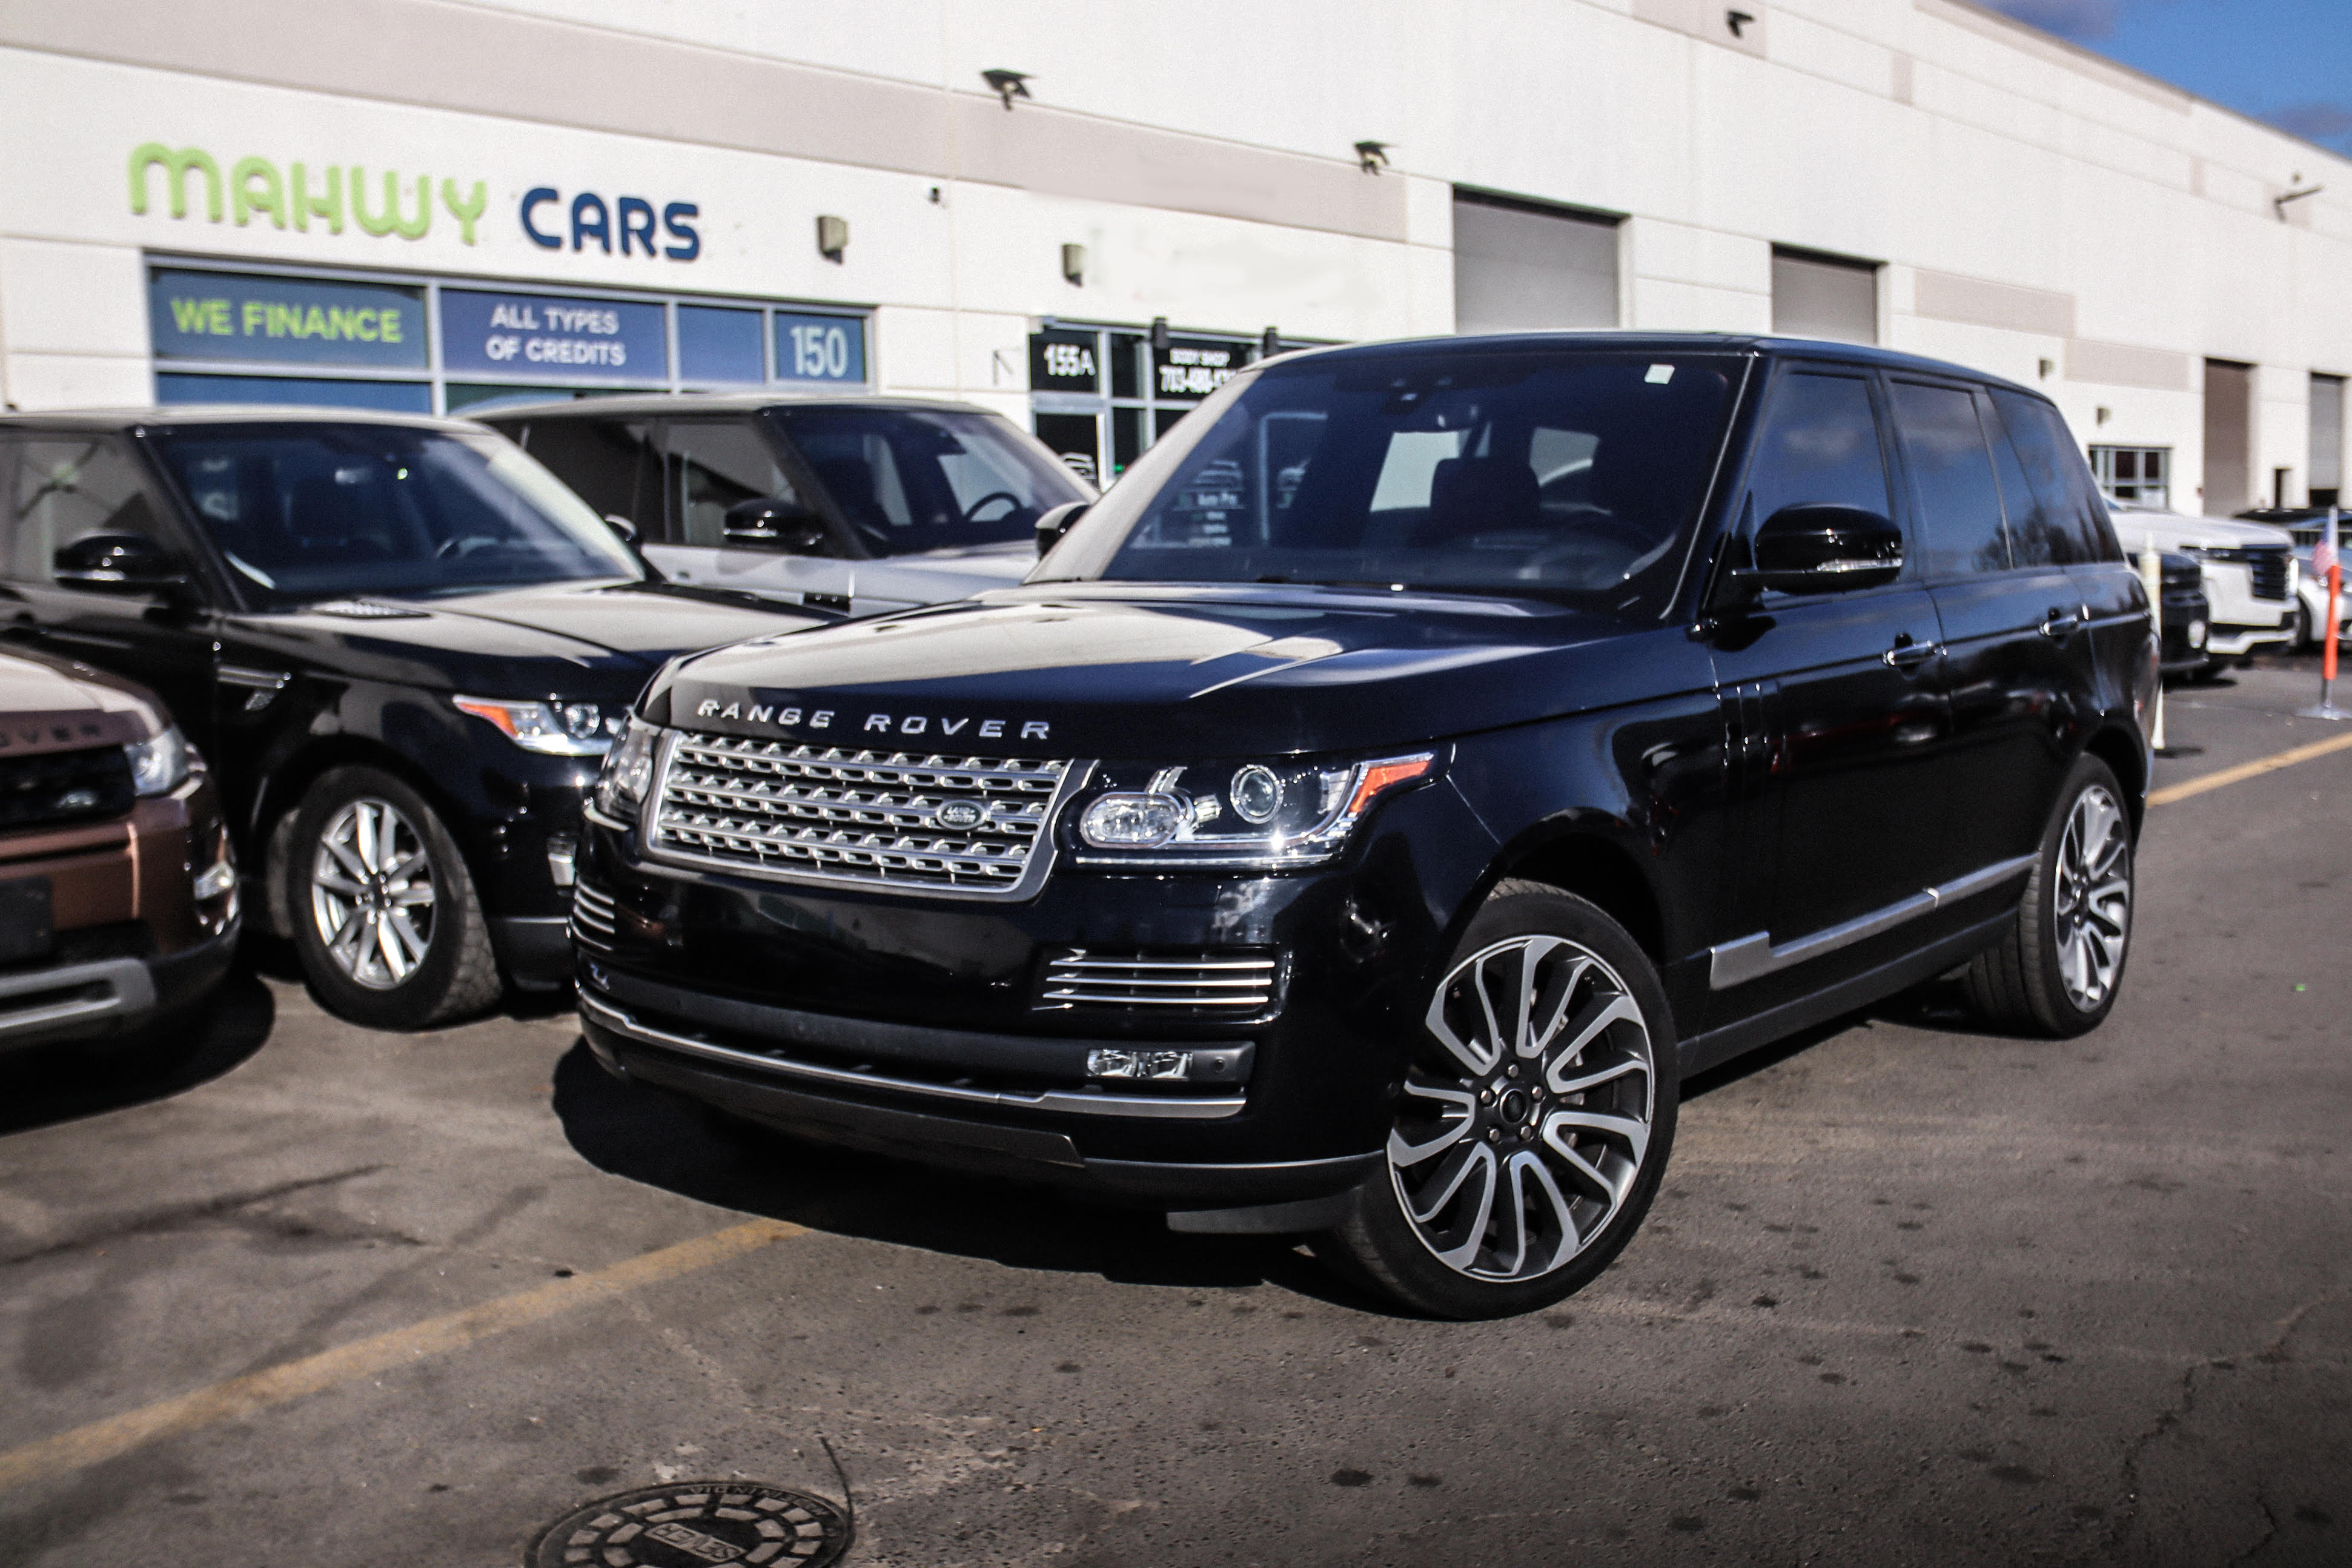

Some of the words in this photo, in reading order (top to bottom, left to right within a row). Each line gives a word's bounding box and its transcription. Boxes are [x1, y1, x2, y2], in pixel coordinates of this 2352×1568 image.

[127, 141, 487, 246] MAHWY
[521, 187, 700, 260] CARS
[171, 298, 233, 336] WE
[243, 302, 403, 343] FINANCE
[491, 305, 538, 331] ALL
[546, 308, 619, 336] TYPES
[486, 335, 520, 360] OF
[525, 337, 626, 366] CREDITS
[789, 325, 847, 377] 150
[1044, 343, 1096, 377] 155A
[697, 700, 835, 728] RANGE
[864, 714, 1050, 739] ROVER
